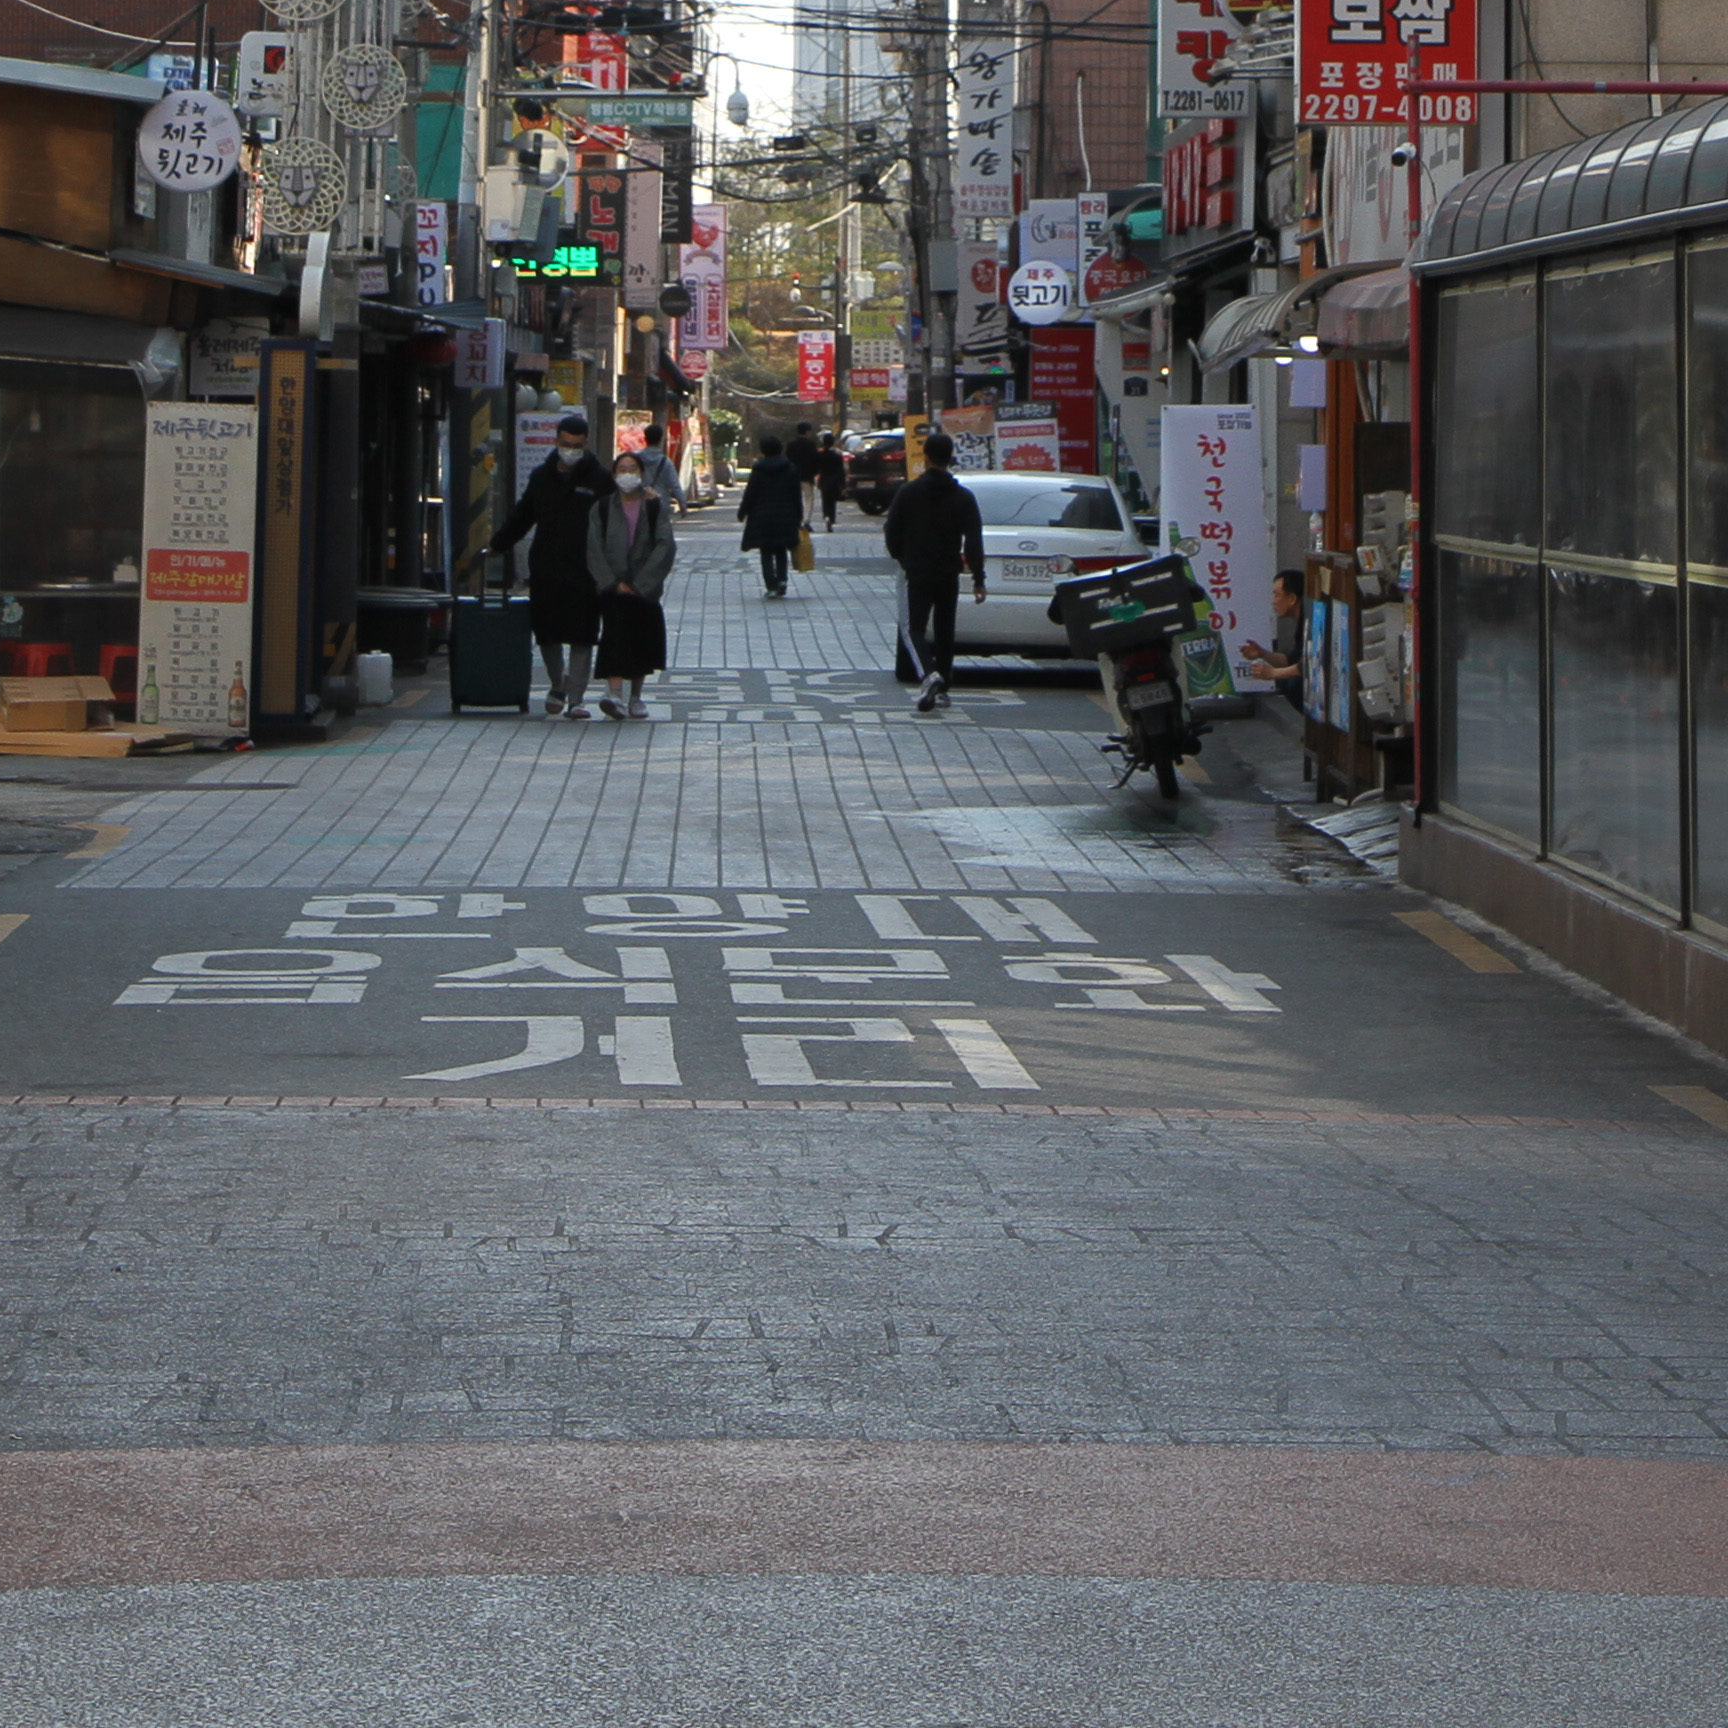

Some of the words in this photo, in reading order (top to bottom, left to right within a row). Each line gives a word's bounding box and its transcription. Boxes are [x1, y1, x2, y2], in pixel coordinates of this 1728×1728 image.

[1320, 62, 1459, 90] 포장판매
[1163, 90, 1245, 112] T.2281-0617
[161, 121, 208, 149] 제주
[157, 148, 224, 179] 뒷고기
[1026, 269, 1054, 281] 제주
[1012, 286, 1068, 307] 뒷고기
[805, 345, 828, 390] 부동산
[1196, 433, 1237, 631] 천국떡볶이
[1180, 634, 1218, 658] TERRA
[284, 890, 1098, 943] 한양대
[112, 946, 1282, 1012] 음식문화
[400, 1014, 1043, 1088] 거리
